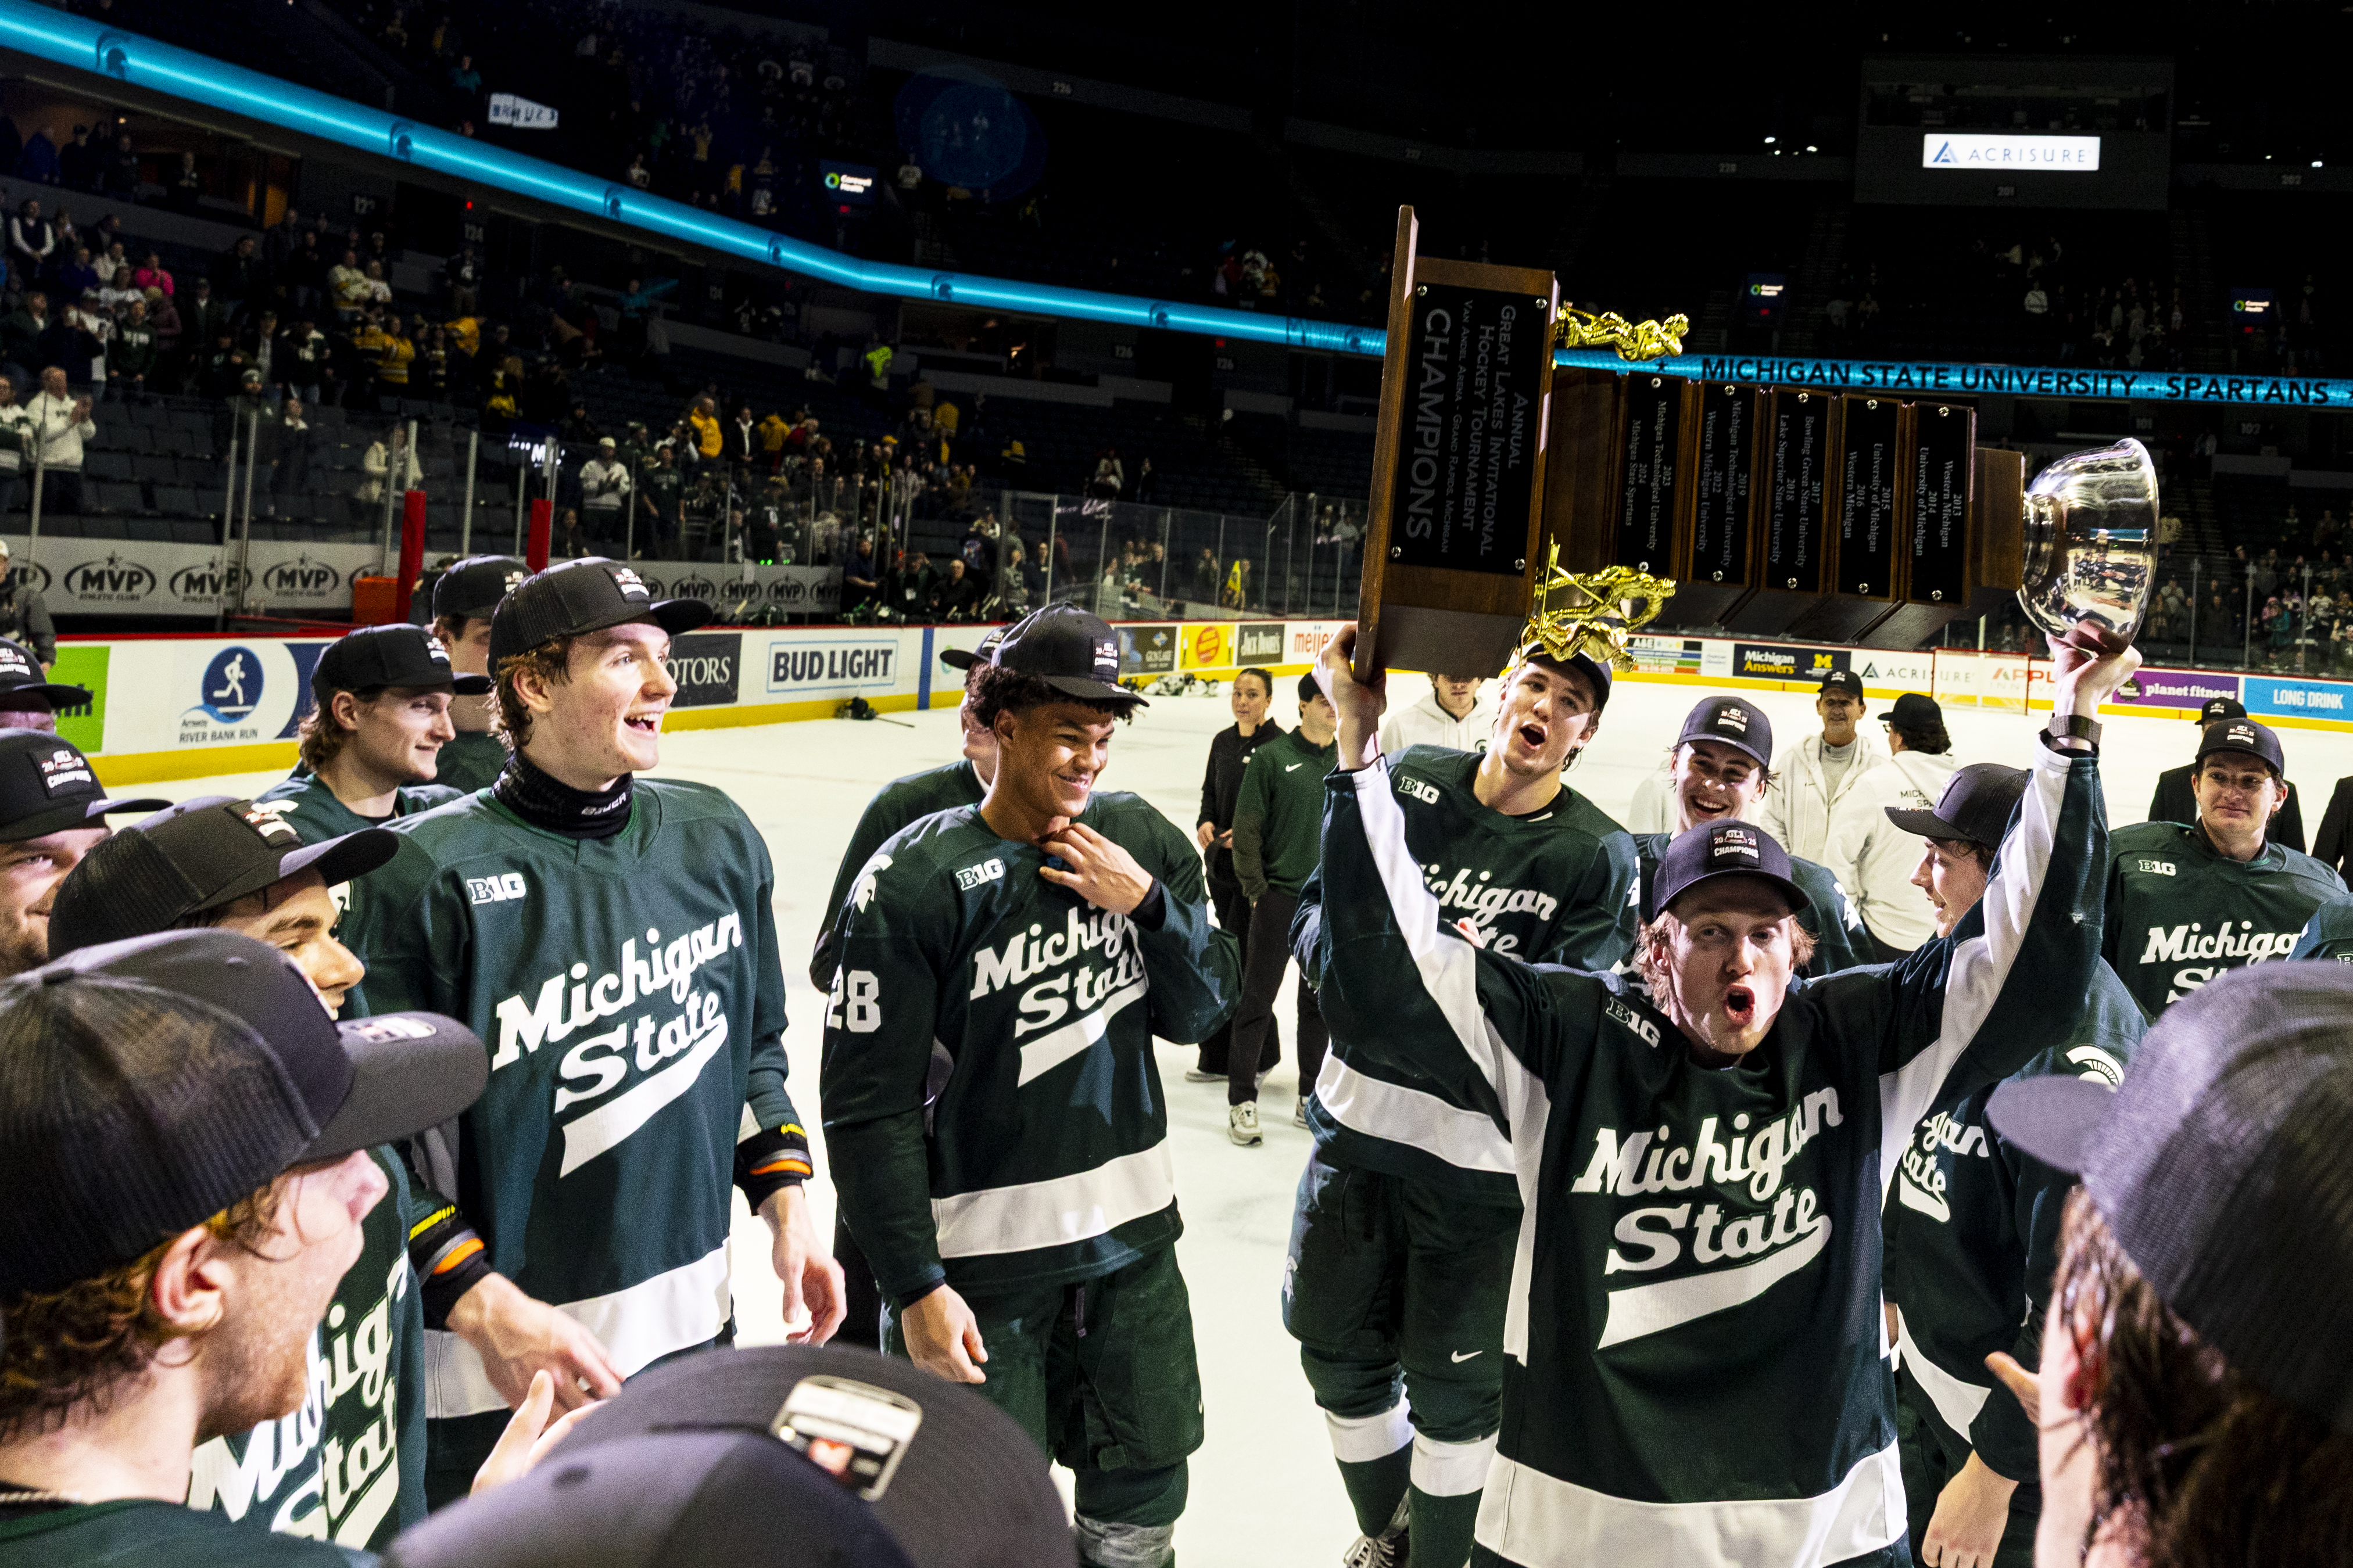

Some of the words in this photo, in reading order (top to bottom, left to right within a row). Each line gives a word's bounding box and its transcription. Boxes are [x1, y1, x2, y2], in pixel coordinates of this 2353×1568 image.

[1969, 148, 2085, 162] ACRISURE
[1463, 299, 1473, 323] VAN
[1459, 326, 1470, 362] ANDEL
[1497, 304, 1517, 365] GREAT
[1473, 324, 1495, 400] HOCKEY
[1702, 357, 1849, 385] MICHIGAN
[1861, 364, 1948, 389] STATE
[1961, 366, 2136, 395] UNIVERSITY
[2167, 379, 2329, 403] SPARTANS
[1455, 364, 1467, 402] ARENA
[1491, 370, 1511, 430] LAKES
[1406, 308, 1452, 539] CHAMPIONS
[1450, 414, 1462, 452] GRAND
[1508, 391, 1528, 469] ANNUAL
[1654, 400, 1667, 442] Michigan
[1704, 410, 1717, 450] Western
[1728, 400, 1742, 446] Michigan
[1779, 414, 1789, 439] Lake
[1801, 415, 1814, 455] Bowling
[1628, 419, 1641, 460] Michigan
[1462, 407, 1488, 530] TOURNAMENT
[1628, 462, 1638, 485] State
[1650, 443, 1664, 503] Technological
[1662, 465, 1672, 486] 2023
[1700, 453, 1713, 498] Michigan
[1775, 440, 1788, 484] Superior
[1801, 457, 1812, 487] Green
[1846, 451, 1857, 490] Western
[1869, 443, 1883, 492] University
[1916, 447, 1929, 497] University
[1943, 460, 1954, 500] Western
[1480, 436, 1505, 556] INVITATIONAL
[1713, 469, 1722, 493] 2022
[1725, 447, 1739, 514] Technological
[1738, 472, 1747, 496] 2019
[1775, 486, 1785, 511] State
[1786, 478, 1796, 501] 2018
[1811, 480, 1821, 504] 2017
[1856, 483, 1866, 507] 2016
[1881, 486, 1891, 511] 2015
[1625, 487, 1636, 526] Spartans
[1800, 489, 1810, 515] State
[1842, 493, 1855, 539] Michigan
[1871, 493, 1881, 505] of
[1918, 498, 1927, 510] of
[1928, 490, 1937, 514] 2014
[1953, 493, 1962, 516] 2013
[1441, 500, 1455, 553] MICHIGAN
[1646, 505, 1660, 551] University
[1696, 501, 1710, 552] University
[1720, 516, 1735, 568] University
[1769, 512, 1783, 564] University
[1795, 516, 1809, 568] University
[1867, 507, 1880, 552] Michigan
[1914, 511, 1927, 557] Michigan
[1939, 502, 1951, 548] Michigan
[81, 569, 143, 591] MVP
[185, 567, 239, 594] MVP
[277, 569, 329, 588] MVP
[679, 584, 709, 598] MVP
[728, 584, 755, 598] MVP
[775, 584, 800, 598] MVP
[1294, 625, 1334, 659] meije
[1745, 650, 1795, 666] Michigan
[666, 656, 731, 686] OTORS
[773, 651, 825, 682] BUD
[828, 649, 893, 679] LIGHT
[1744, 660, 1795, 674] Answers
[1814, 654, 1833, 668] M
[1886, 668, 1971, 683] ACRIURE
[1993, 668, 2055, 683] APPL
[2145, 683, 2189, 697] planet
[2189, 685, 2236, 699] fitness
[2273, 689, 2305, 706] LONG
[2307, 691, 2344, 709] DRINK
[179, 731, 207, 743] RIVER
[211, 729, 237, 741] BANK
[239, 729, 259, 740] RUN
[1718, 718, 1746, 732] CHAMPIONS
[47, 770, 91, 788] CHAMPIONS
[1714, 837, 1724, 845] 20
[1747, 837, 1757, 846] 25
[1726, 830, 1743, 838] GLI
[1714, 846, 1759, 859] CHAMPIONS
[2140, 921, 2301, 967] Michiga
[492, 908, 743, 1072] Michigan
[826, 970, 881, 1034] 28
[554, 989, 728, 1115] State
[1571, 1086, 1844, 1202] Michigan
[1605, 1187, 1822, 1276] State
